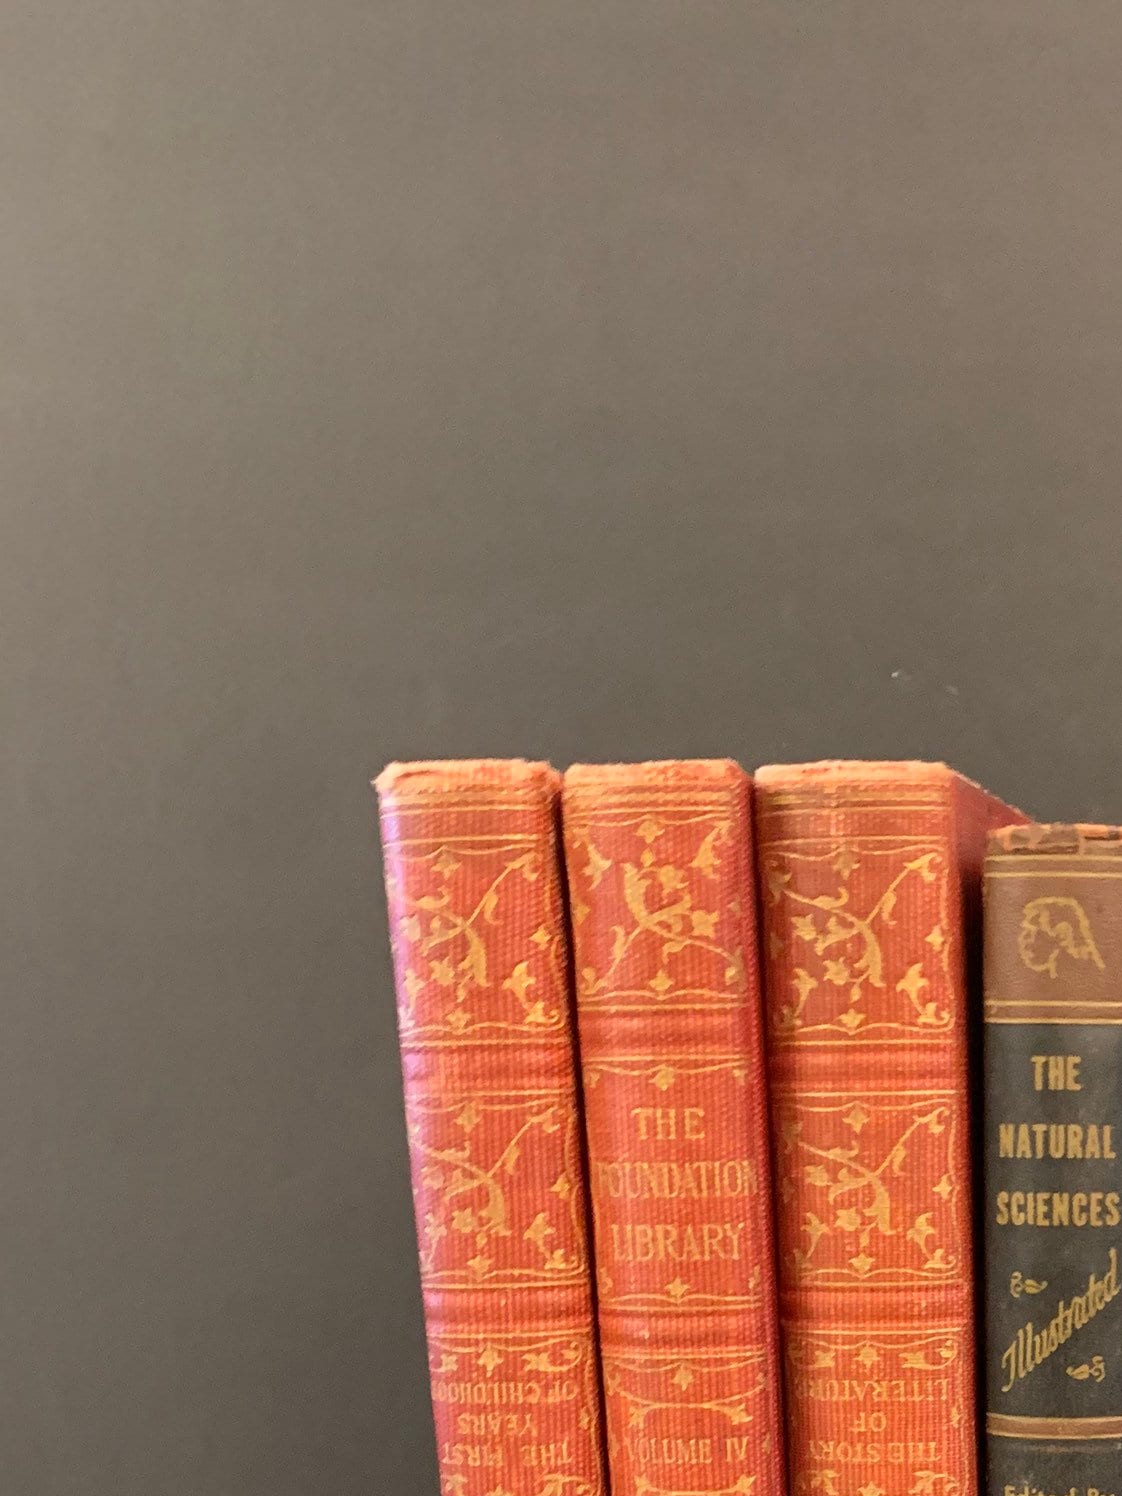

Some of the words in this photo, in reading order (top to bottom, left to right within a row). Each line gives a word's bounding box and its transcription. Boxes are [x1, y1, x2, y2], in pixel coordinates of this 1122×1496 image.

[1031, 1055, 1083, 1092] THE
[630, 1106, 706, 1141] THE
[998, 1123, 1117, 1160] NATURAL
[995, 1191, 1122, 1227] SCIENCES
[610, 1222, 746, 1261] LIBRARY
[1000, 1246, 1122, 1393] Illustrated
[546, 1379, 579, 1404] OF
[456, 1412, 538, 1438] YEARS
[849, 1411, 887, 1433] OF
[439, 1441, 504, 1468] FIRST
[520, 1437, 573, 1468] THE
[624, 1437, 713, 1465] VOLUME
[724, 1436, 750, 1463] IV
[887, 1441, 942, 1464] THE
